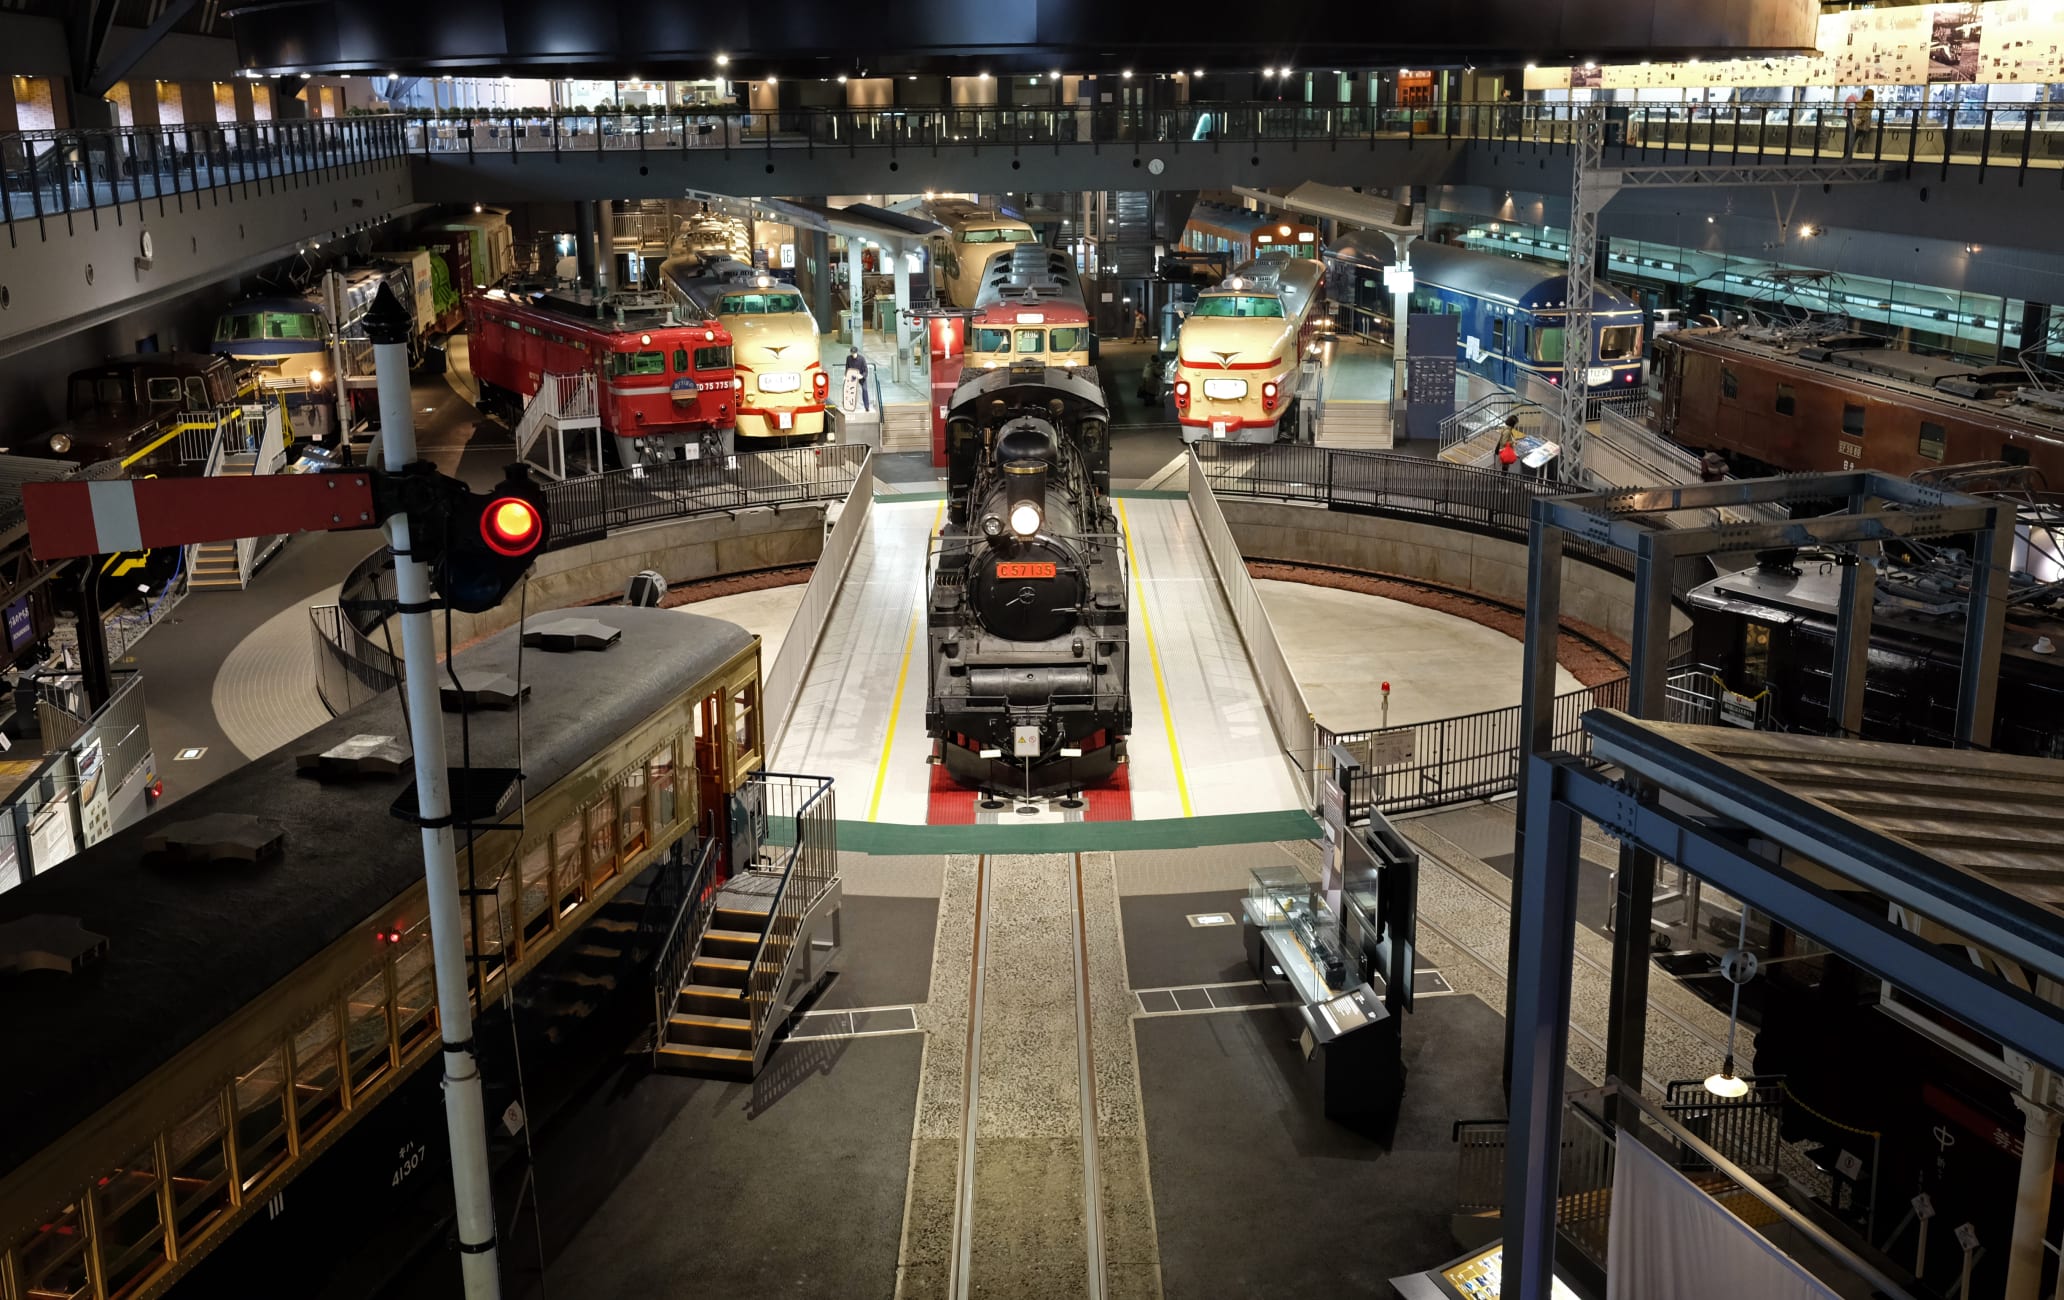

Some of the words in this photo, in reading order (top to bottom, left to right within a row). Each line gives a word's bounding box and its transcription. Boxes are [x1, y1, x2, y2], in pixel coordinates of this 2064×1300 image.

[783, 249, 792, 263] 16
[705, 382, 714, 390] 75
[715, 381, 729, 390] 775
[392, 1145, 425, 1187] 41307
